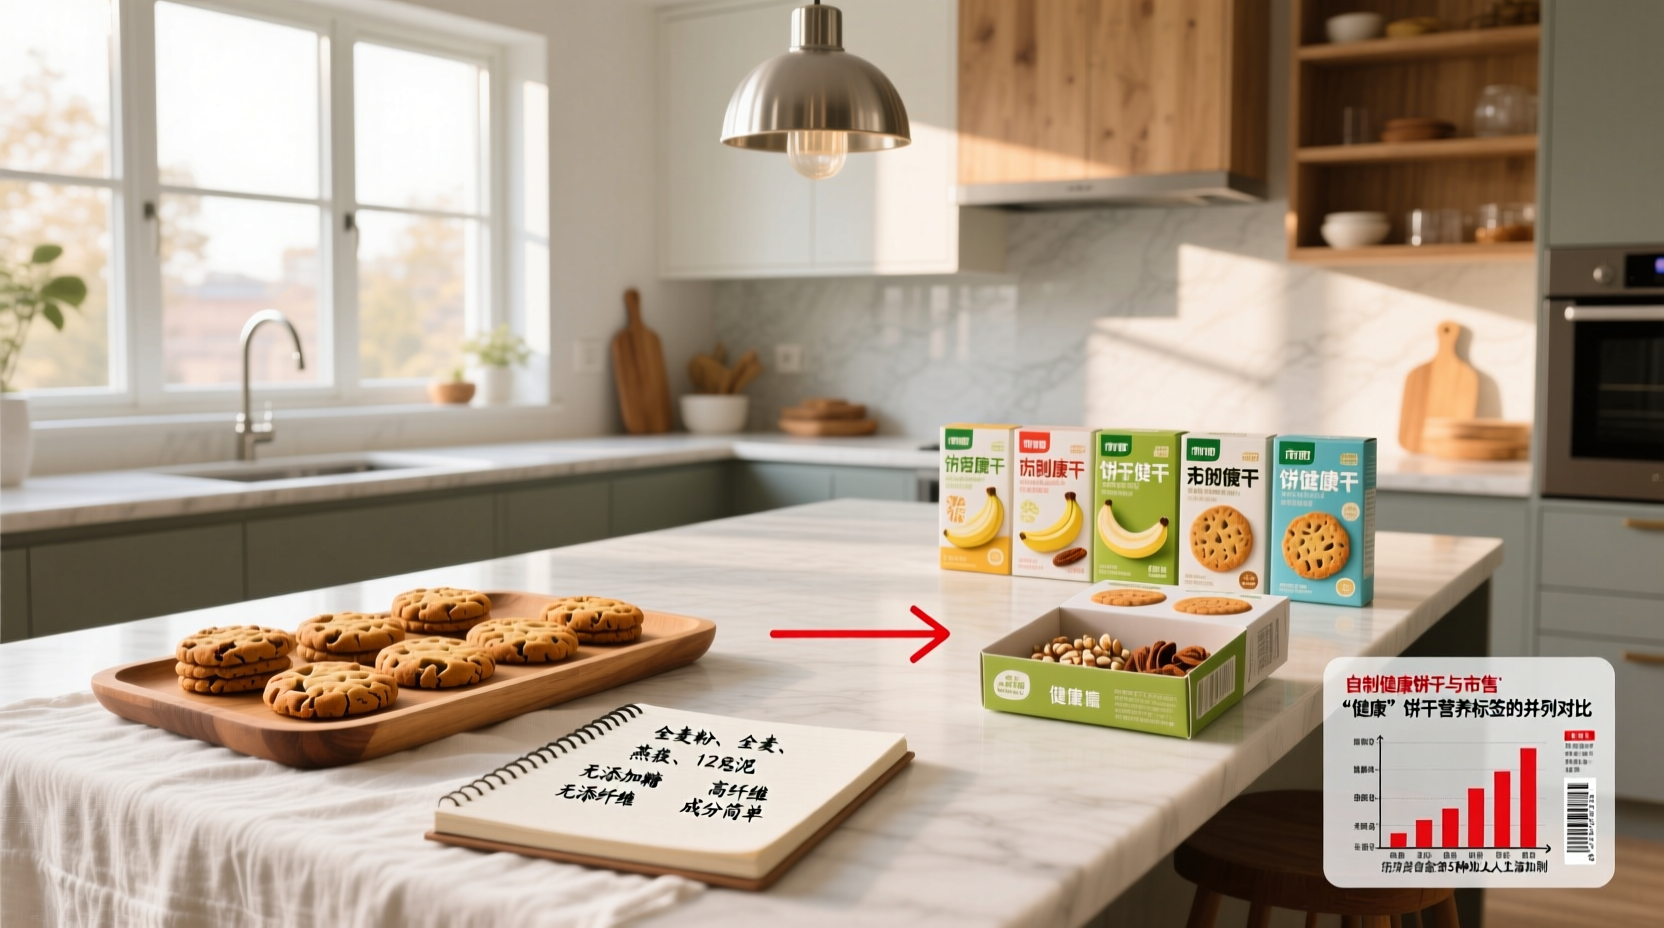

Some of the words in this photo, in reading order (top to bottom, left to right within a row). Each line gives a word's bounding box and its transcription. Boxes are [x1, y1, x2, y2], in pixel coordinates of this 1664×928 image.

[708, 780, 769, 802] 高纤维
[680, 798, 763, 823] 成分简单
